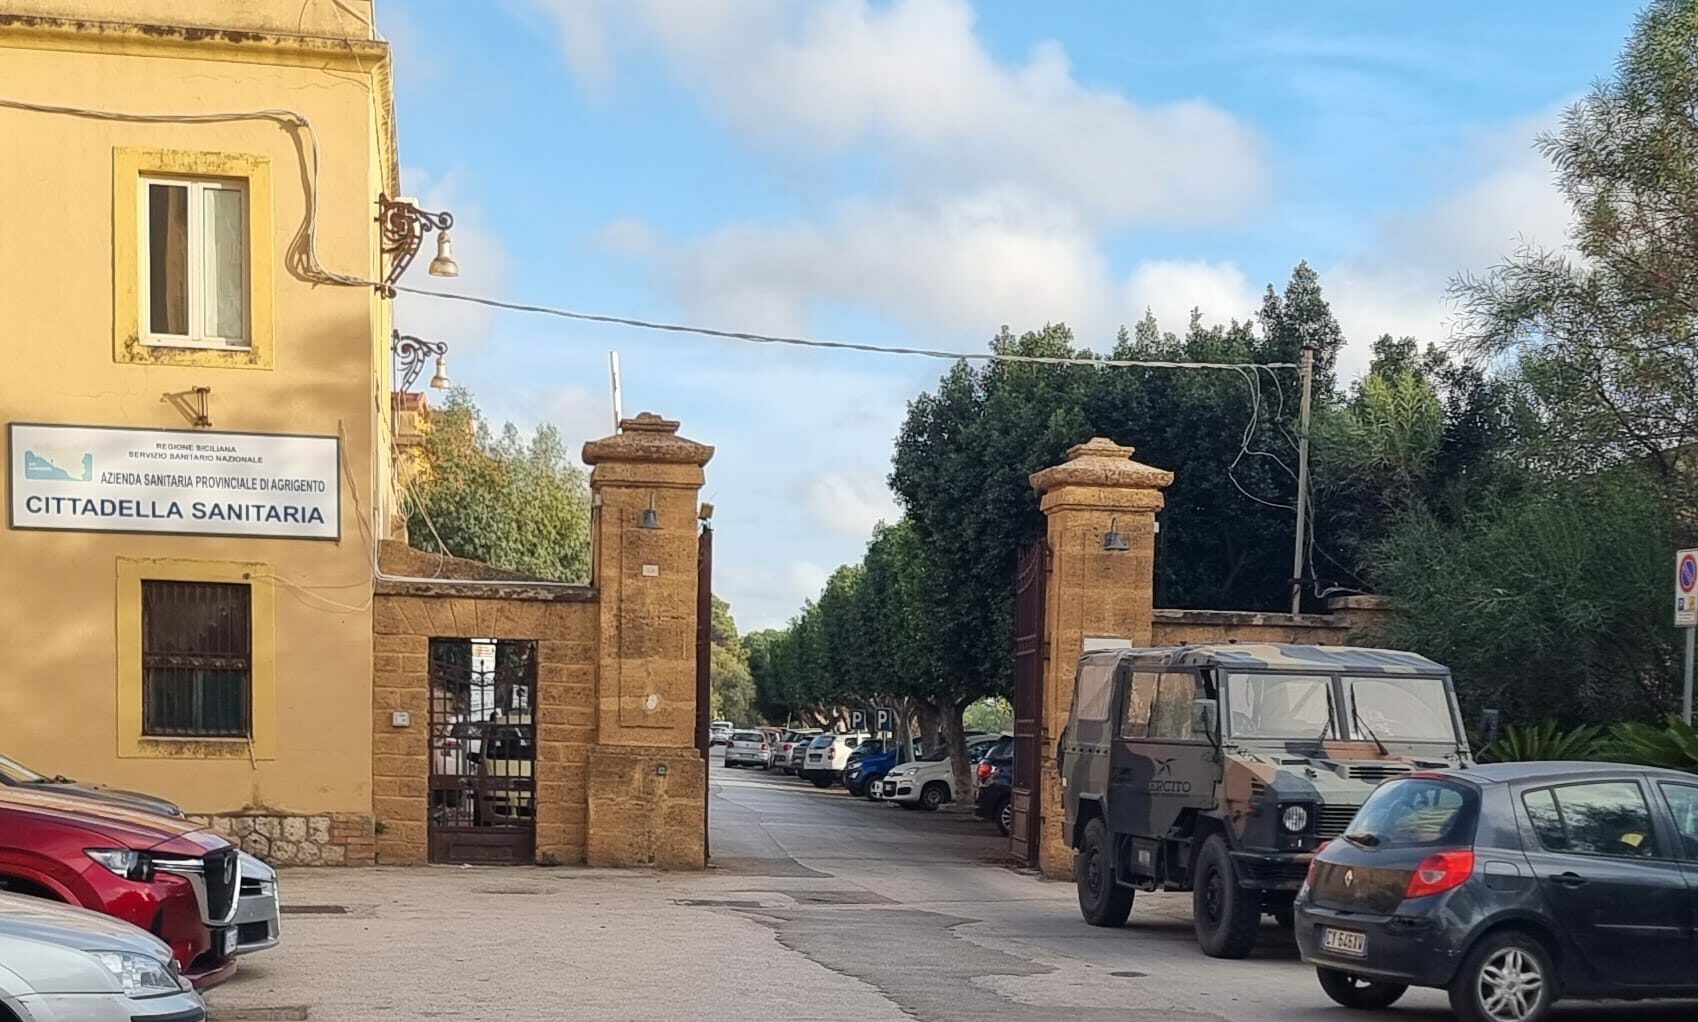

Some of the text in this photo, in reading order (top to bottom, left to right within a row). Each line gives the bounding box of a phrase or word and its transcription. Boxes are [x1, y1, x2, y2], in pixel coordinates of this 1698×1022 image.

[155, 442, 237, 453] REGIONE SICILIANA
[128, 451, 263, 464] SERVIZIO SANITARIO NAZIONALE
[100, 471, 326, 493] AZIENDA SANITARIA PROVINCIALE DI AGRIGENTO
[25, 495, 325, 525] CITTADELLA SANITARIA
[852, 711, 862, 728] P
[878, 710, 887, 729] P
